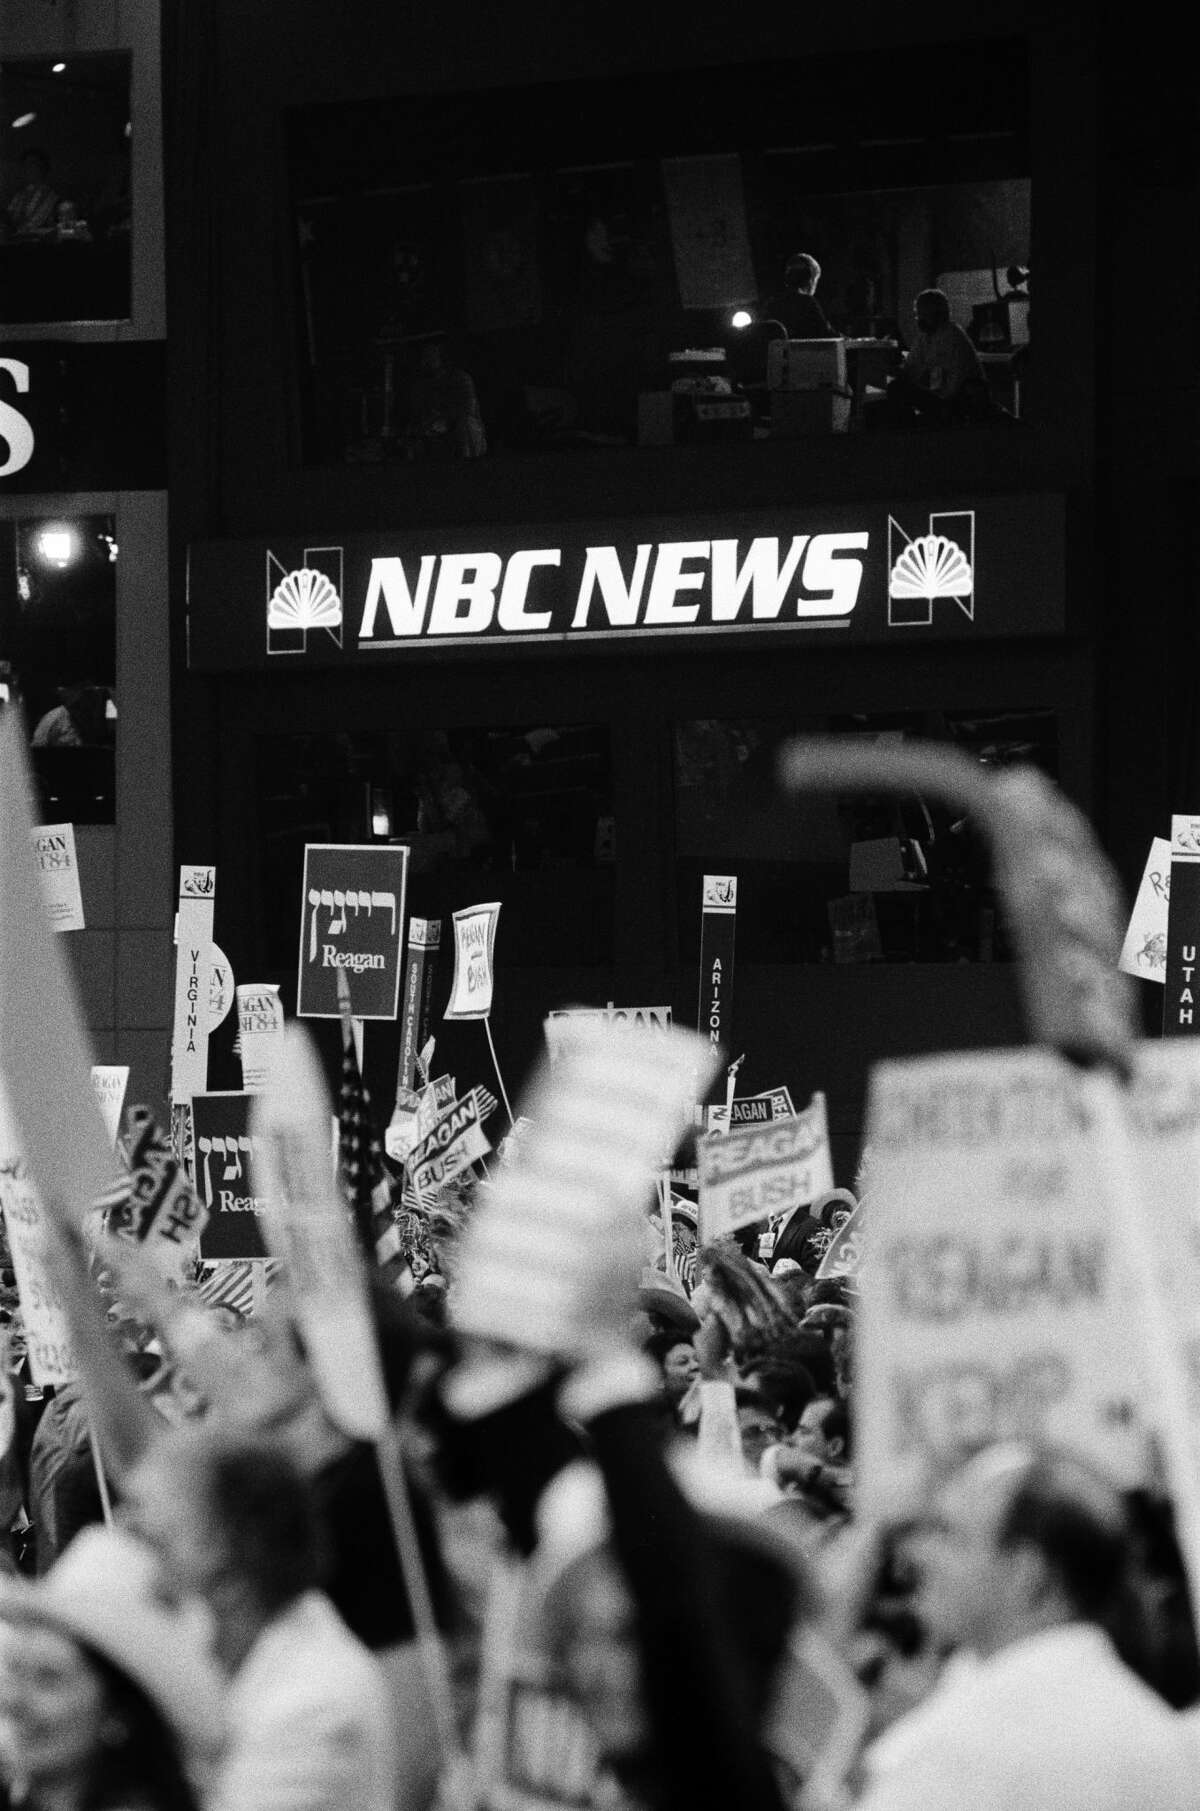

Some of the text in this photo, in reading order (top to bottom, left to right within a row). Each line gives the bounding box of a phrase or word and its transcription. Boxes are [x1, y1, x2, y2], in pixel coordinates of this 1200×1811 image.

[359, 532, 869, 637] NBC NEWS
[322, 944, 385, 974] Reagan
[1179, 945, 1196, 1024] UTAH
[187, 949, 200, 1052] VIRGINIA
[709, 957, 722, 1057] ARIZONA
[402, 1016, 414, 1088] CAROLIN
[734, 1102, 767, 1121] AGAN
[703, 1122, 819, 1178] REAGA
